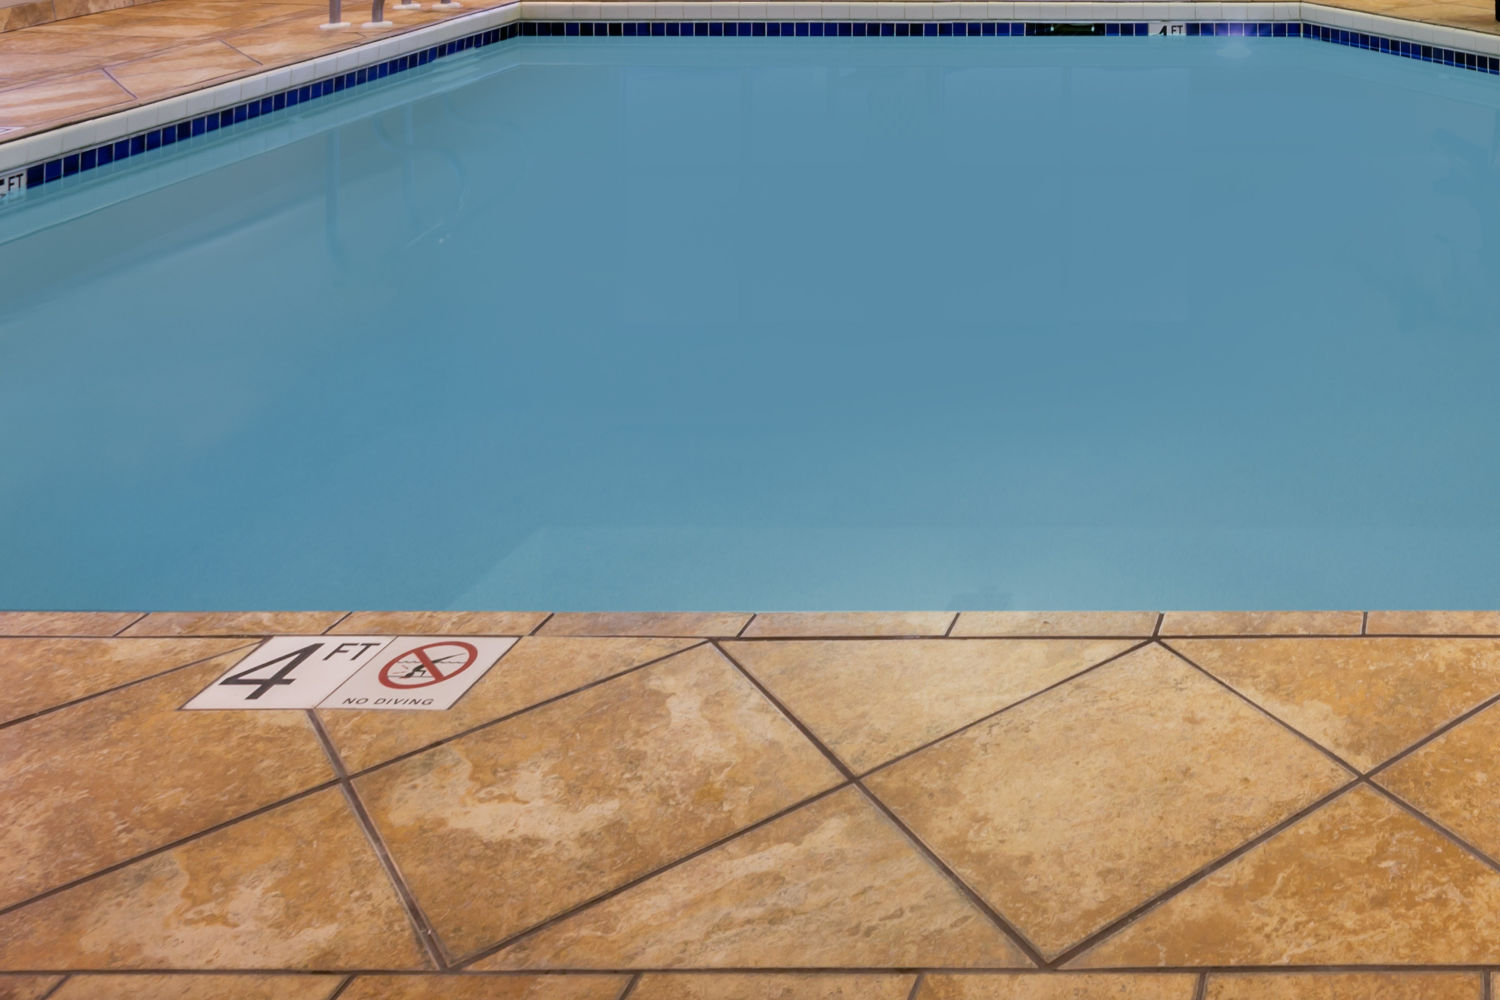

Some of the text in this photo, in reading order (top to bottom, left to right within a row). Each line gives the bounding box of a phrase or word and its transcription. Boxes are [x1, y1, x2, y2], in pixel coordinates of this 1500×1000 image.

[1171, 25, 1183, 35] FT
[8, 173, 24, 191] FT
[218, 642, 382, 701] 4 FT
[342, 697, 436, 706] NO DIVING
